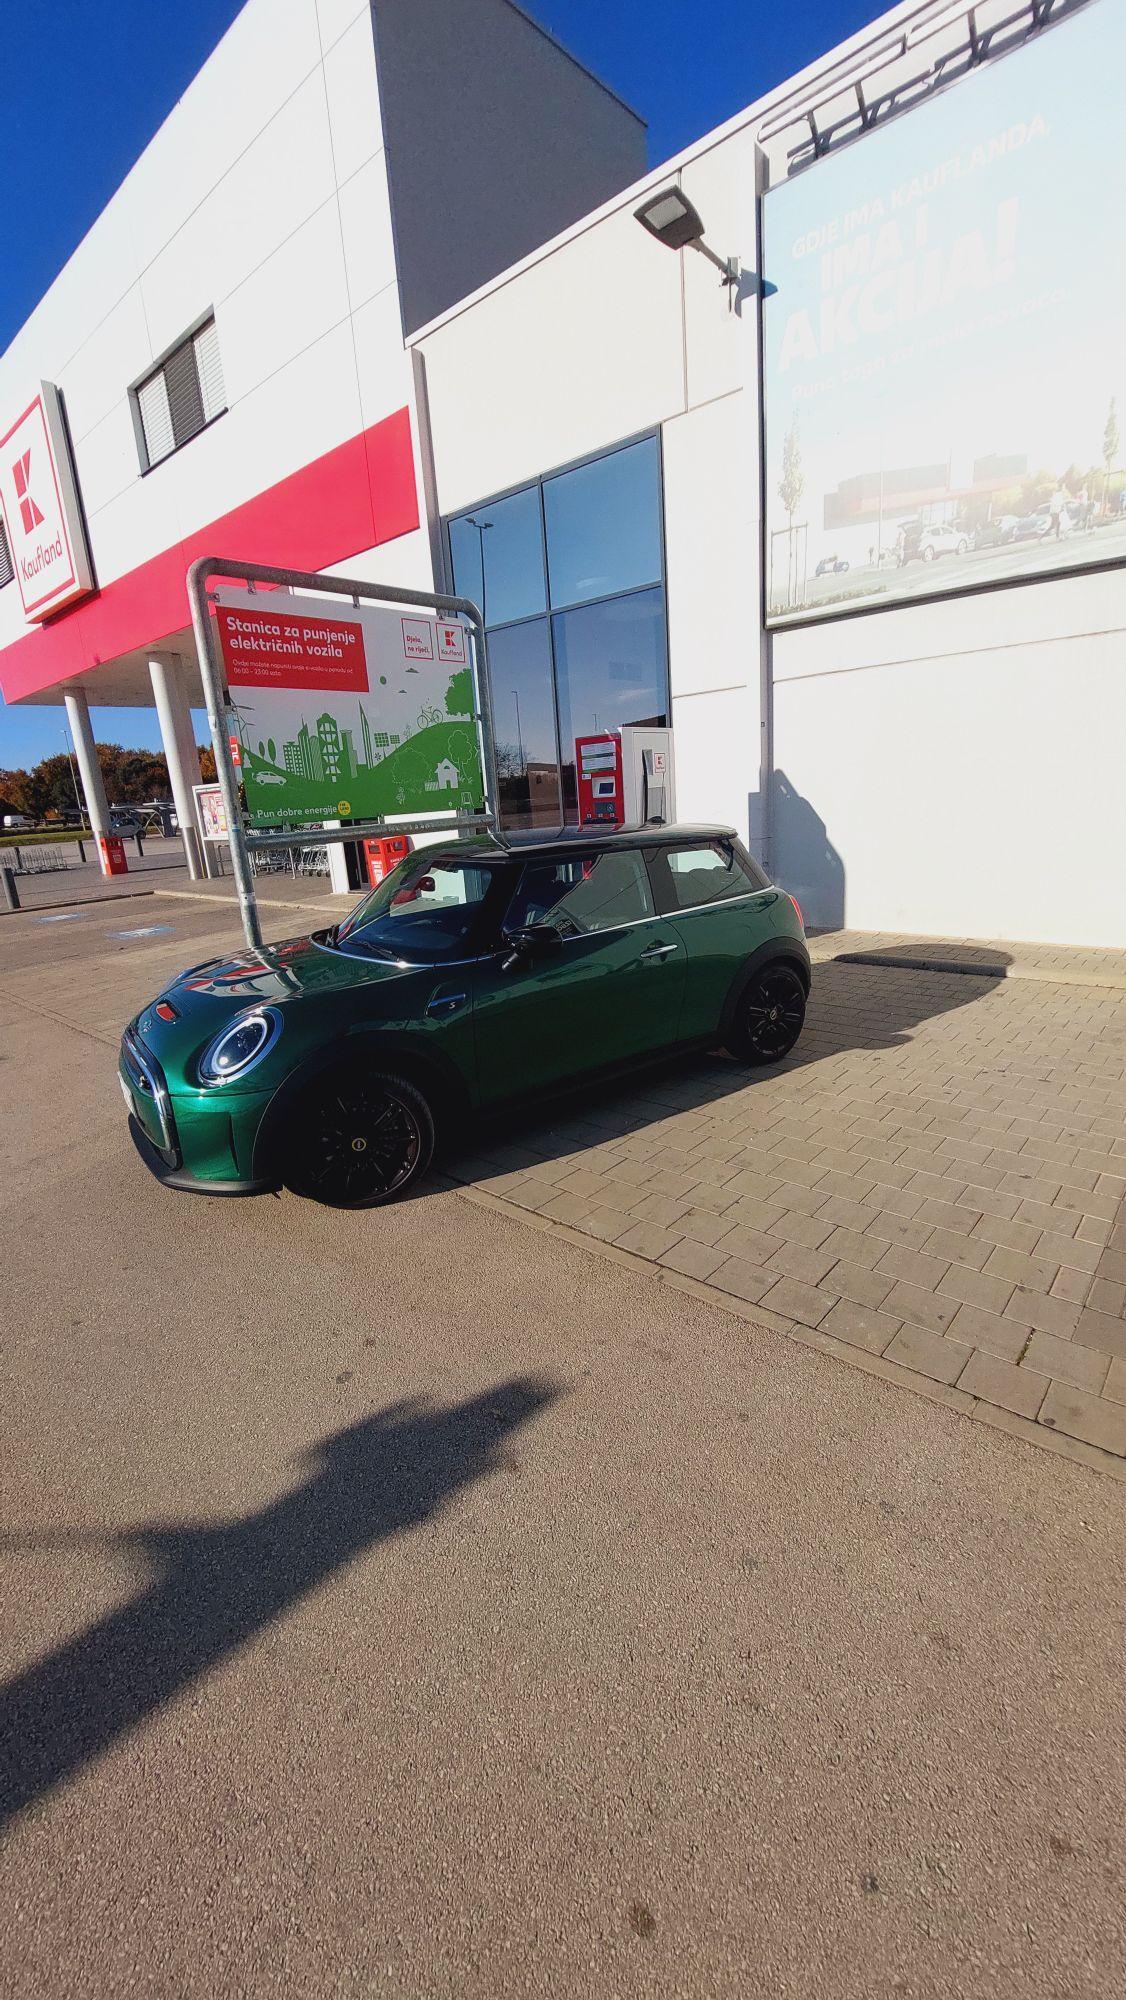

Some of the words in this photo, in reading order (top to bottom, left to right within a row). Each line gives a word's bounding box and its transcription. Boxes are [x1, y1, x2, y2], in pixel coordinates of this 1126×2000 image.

[792, 219, 838, 260] GDJE
[844, 197, 886, 237] IMA
[820, 220, 903, 290] IMA
[914, 202, 928, 248] I
[776, 195, 1020, 373] AKCIJA!
[21, 530, 62, 582] Kaufland
[226, 616, 280, 635] Stanica
[284, 626, 299, 637] za
[303, 628, 355, 645] punjenje
[230, 635, 303, 654] električnih
[306, 643, 343, 658] vozila
[441, 648, 462, 656] Kaufland
[257, 809, 274, 819] Pun
[277, 807, 303, 817] dobre
[304, 804, 338, 815] energije
